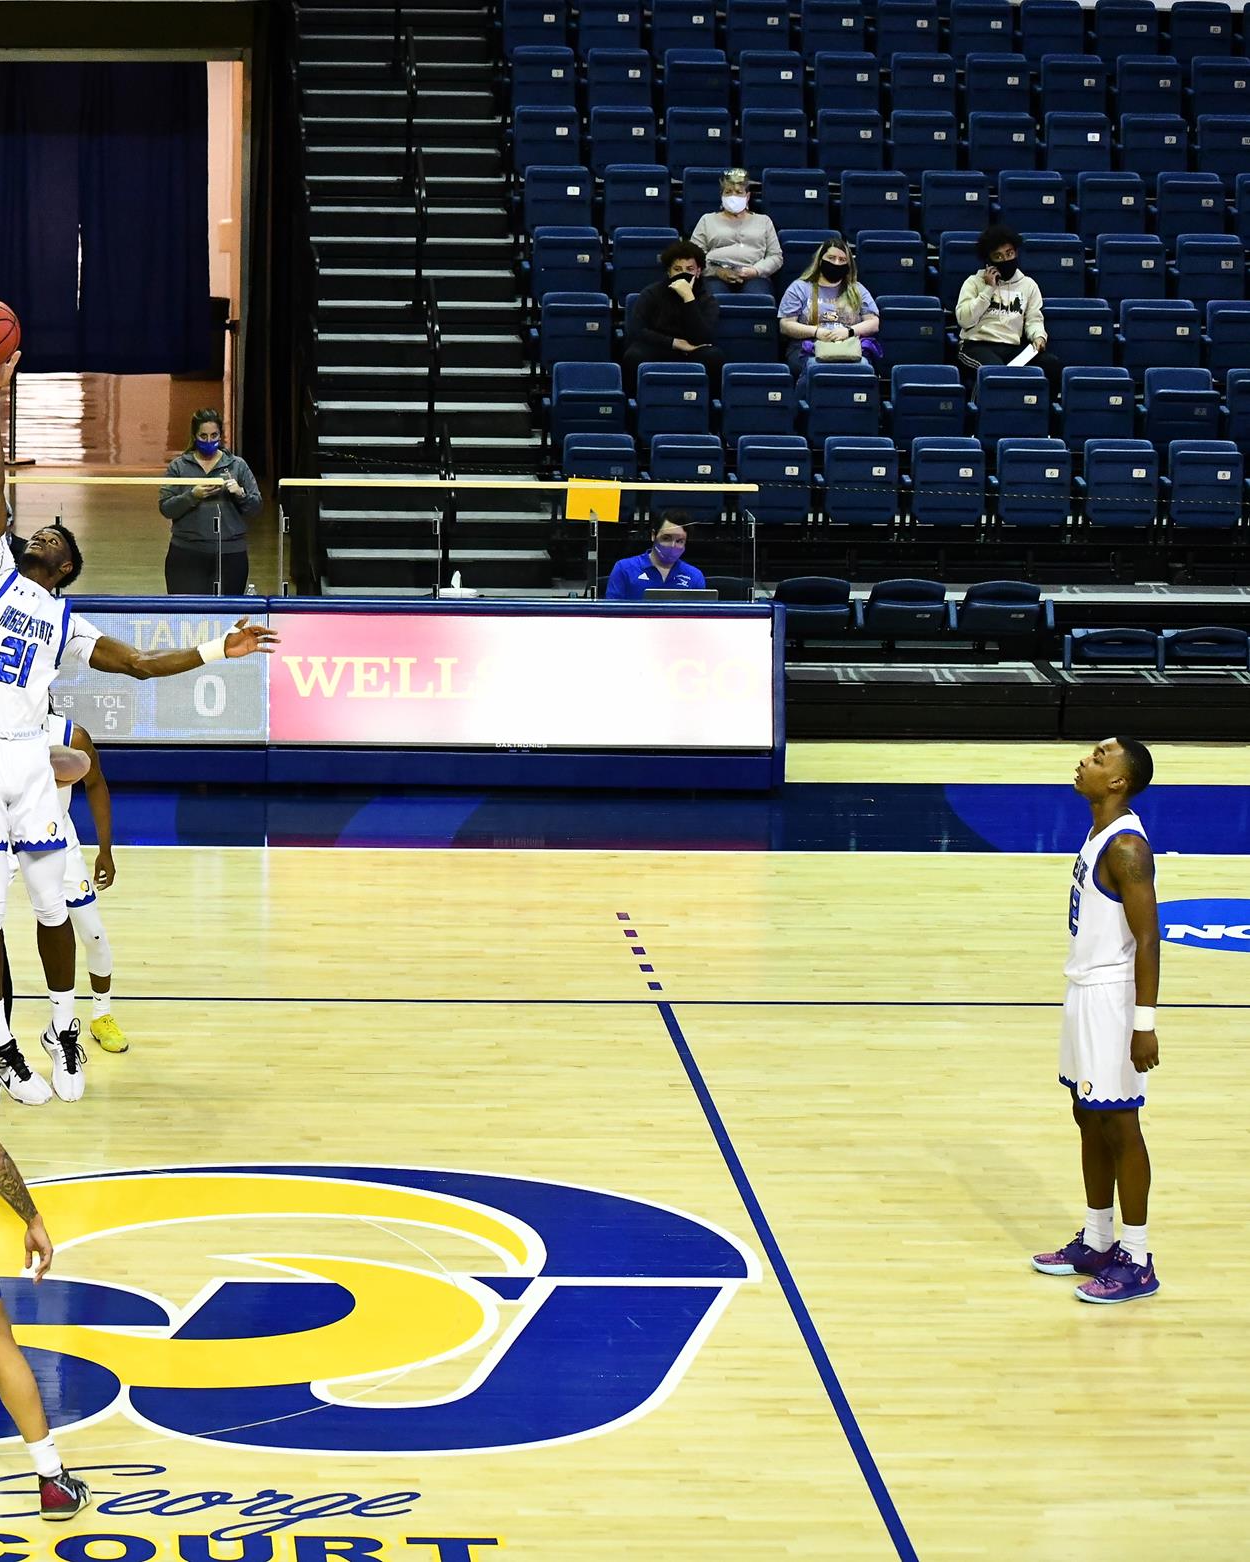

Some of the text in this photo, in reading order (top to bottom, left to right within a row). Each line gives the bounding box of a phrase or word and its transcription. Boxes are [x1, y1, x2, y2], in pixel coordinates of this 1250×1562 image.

[93, 694, 126, 709] TOL
[193, 674, 227, 717] 0
[104, 711, 118, 730] 5
